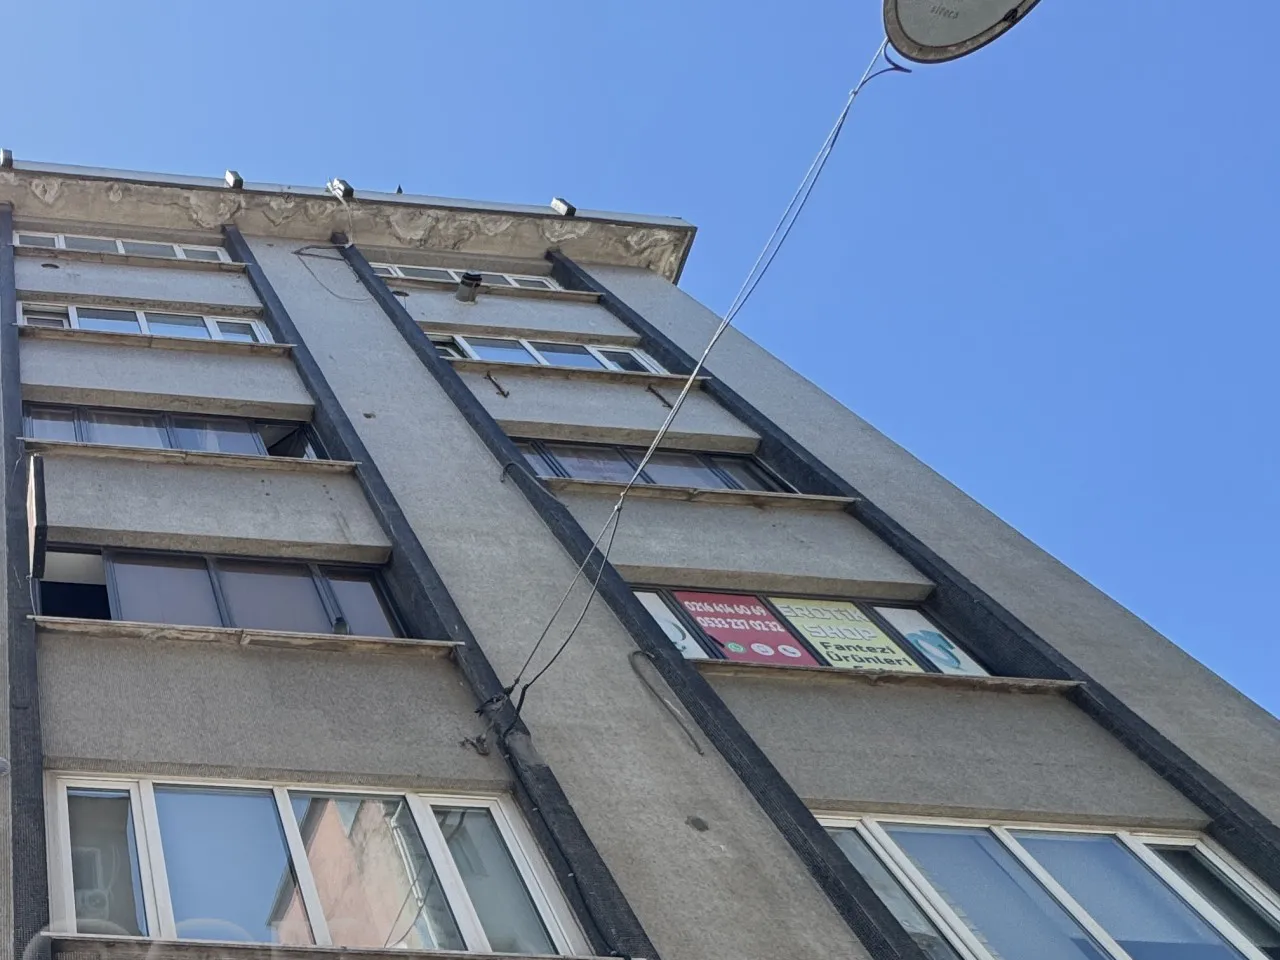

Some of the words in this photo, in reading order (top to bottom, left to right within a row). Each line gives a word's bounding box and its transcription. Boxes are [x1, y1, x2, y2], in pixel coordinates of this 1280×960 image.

[684, 601, 713, 613] 0216
[733, 604, 751, 616] 60
[751, 605, 767, 617] 69
[696, 616, 729, 629] 0533
[820, 641, 897, 655] Fantezi
[825, 651, 913, 667] Ürünleri
